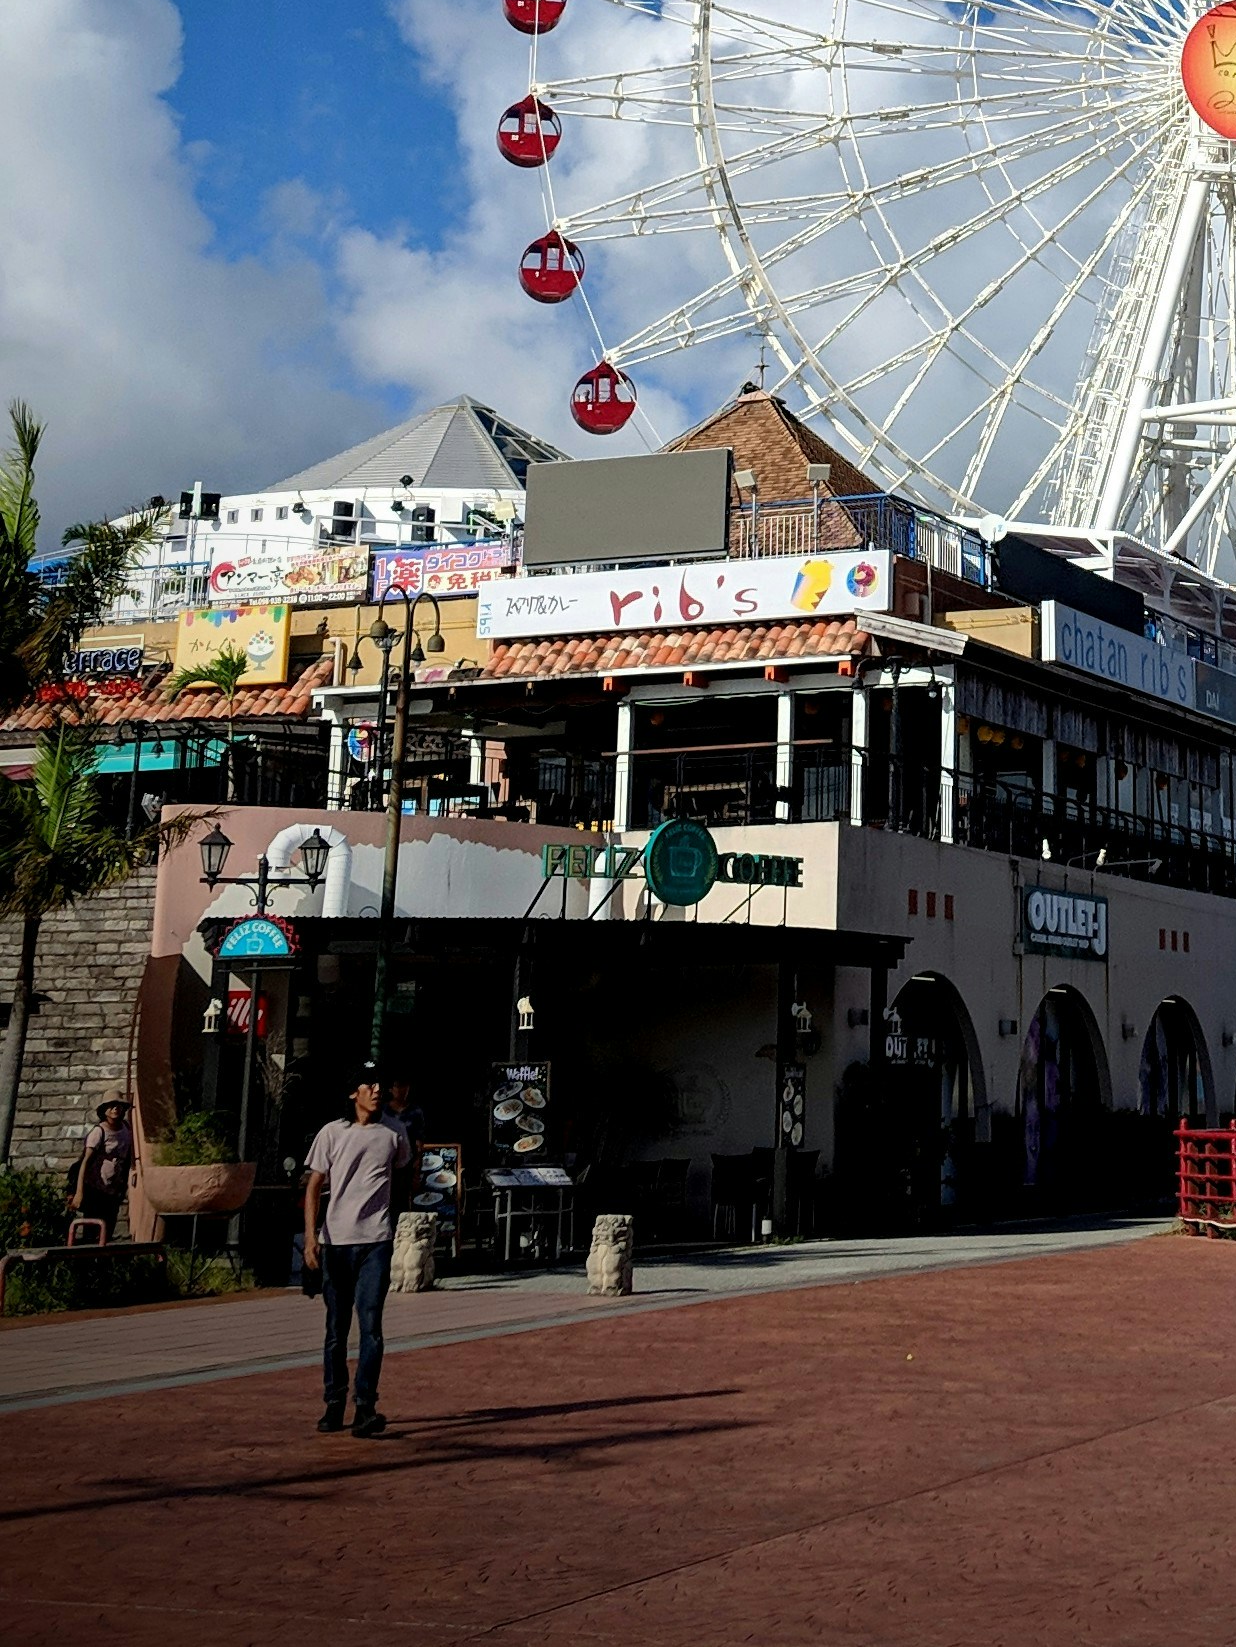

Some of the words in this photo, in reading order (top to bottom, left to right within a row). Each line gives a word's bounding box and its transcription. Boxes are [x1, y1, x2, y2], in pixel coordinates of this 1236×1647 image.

[221, 565, 285, 589] アンマー亭
[390, 555, 423, 594] 薬
[446, 570, 492, 591] 免税
[610, 567, 758, 626] rib's
[64, 647, 141, 673] errace
[1061, 611, 1128, 685] chatan
[1140, 647, 1187, 702] rib's
[543, 844, 638, 879] FELIZ
[226, 923, 251, 951] FELIZ
[251, 922, 284, 949] COFFEE
[1028, 891, 1106, 955] OUTLET-J
[506, 1065, 539, 1081] Waffle!
